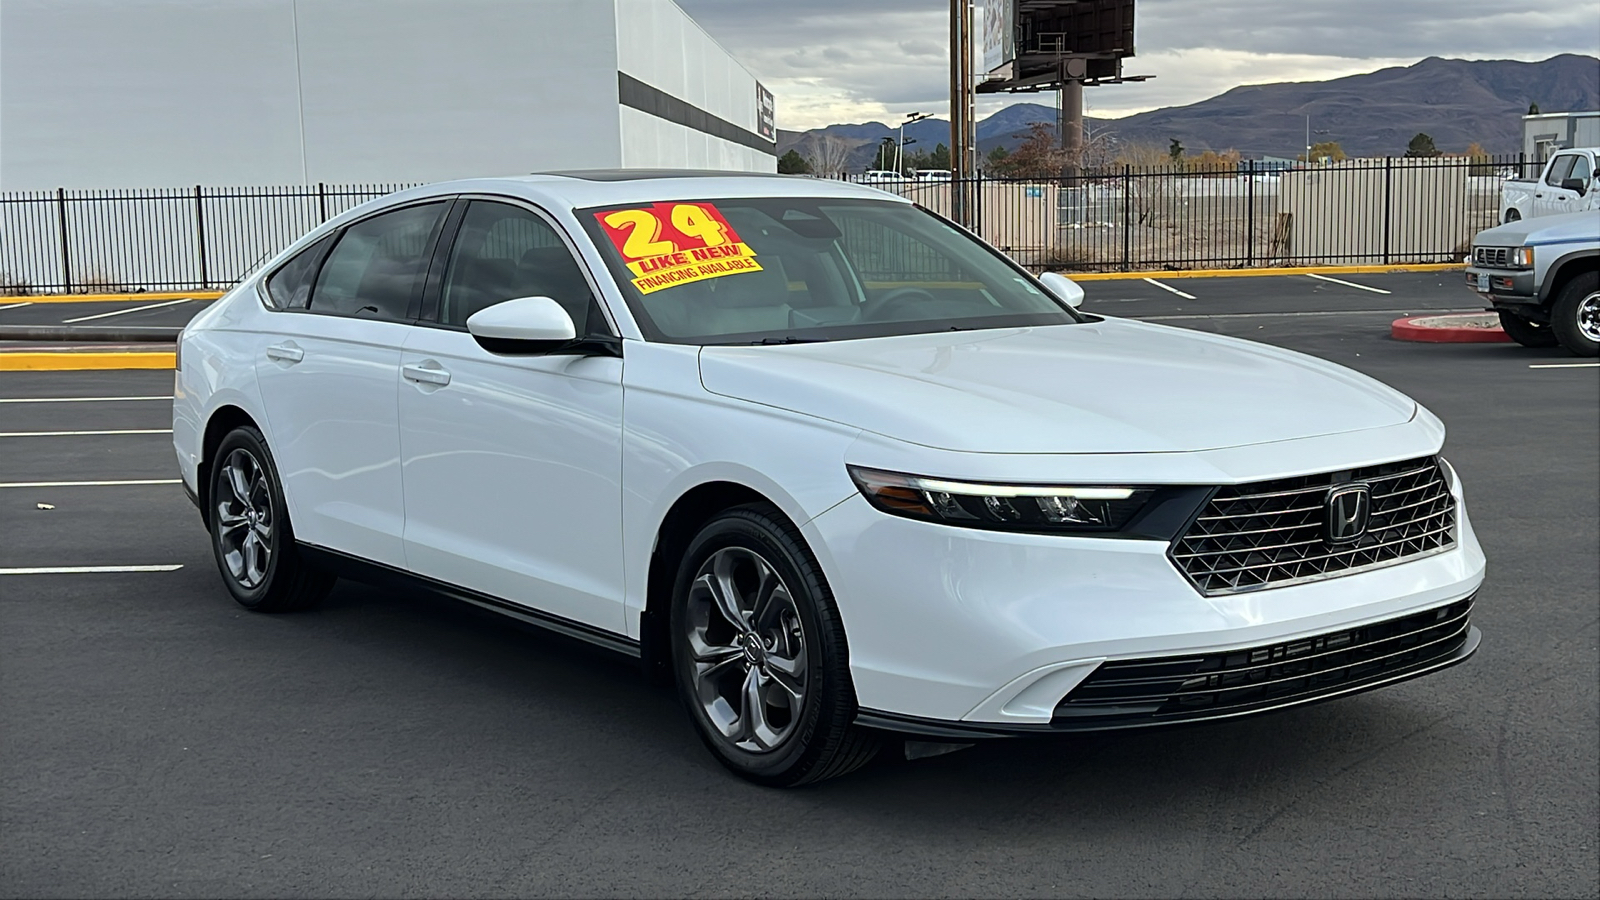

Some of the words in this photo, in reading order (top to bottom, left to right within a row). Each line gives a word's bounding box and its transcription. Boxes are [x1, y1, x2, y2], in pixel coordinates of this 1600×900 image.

[604, 204, 732, 258] 24
[636, 267, 699, 290] FINANCING
[697, 258, 757, 276] AVAILABLE
[638, 252, 689, 274] LIKE
[691, 245, 741, 260] NEW
